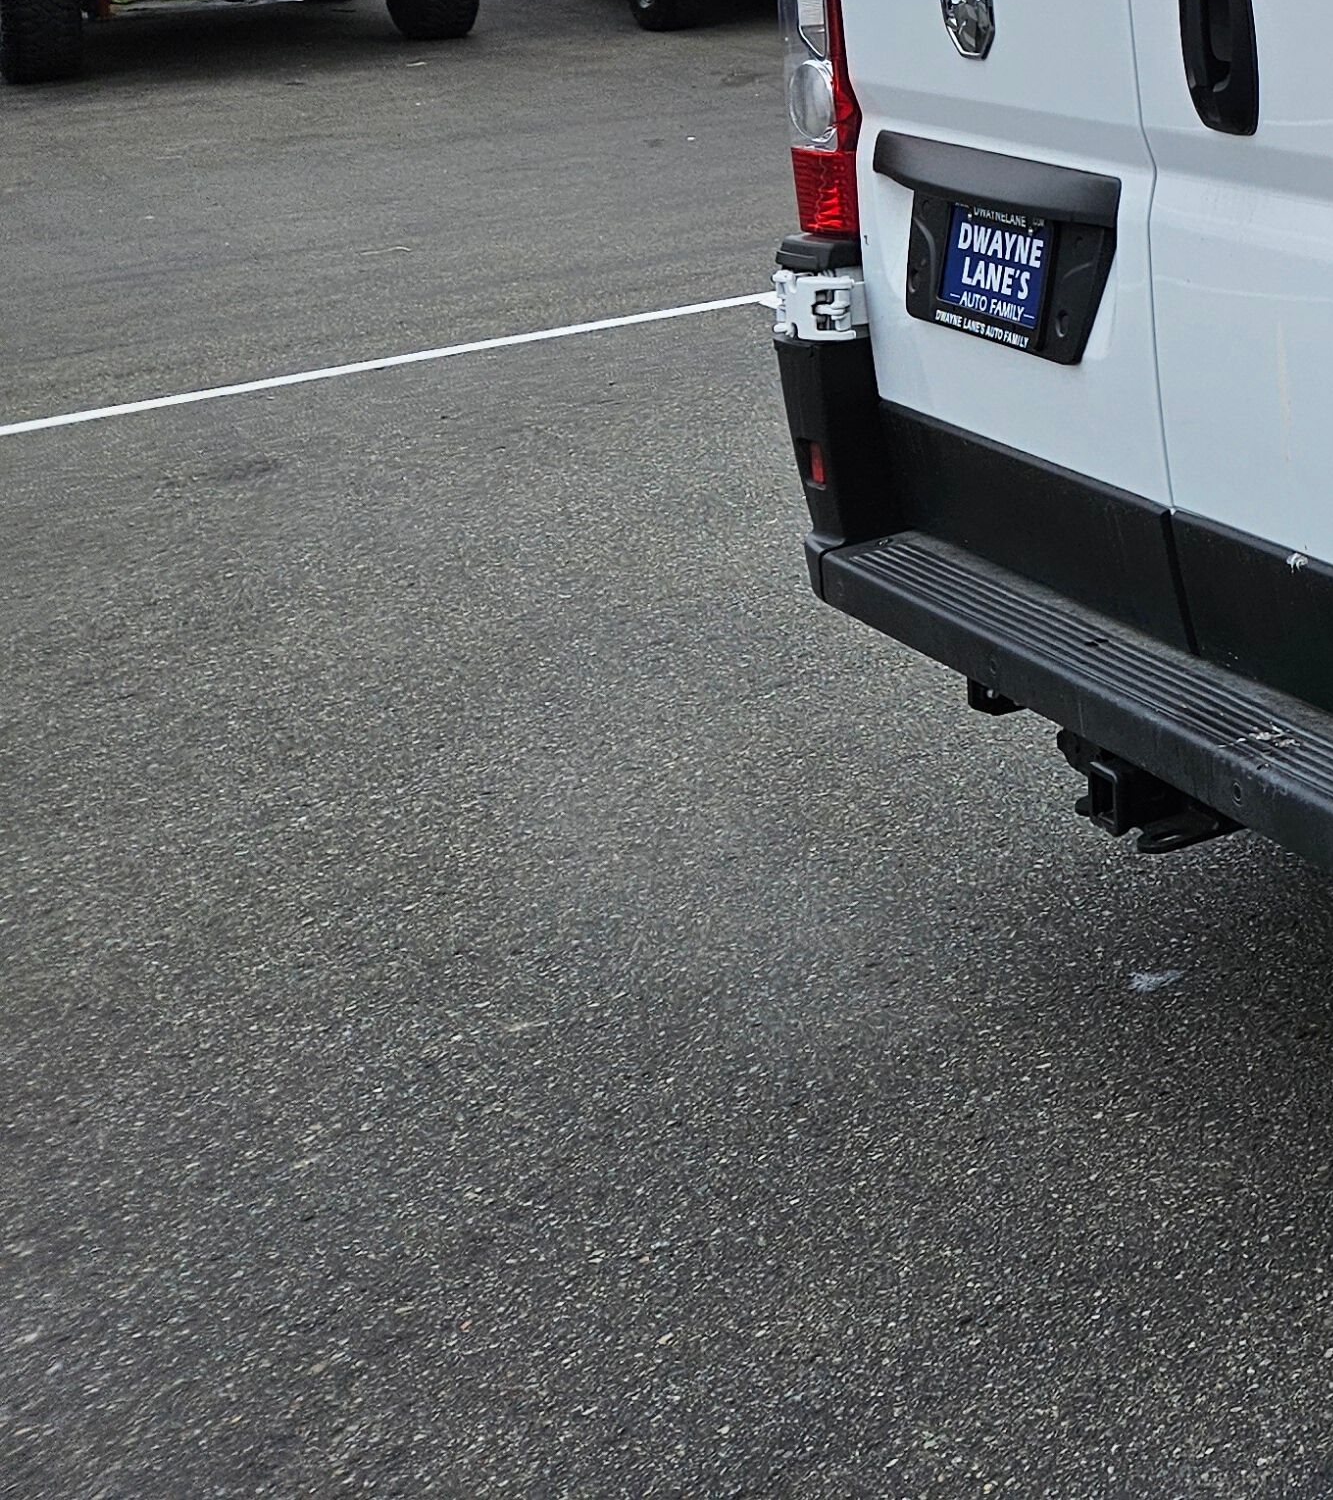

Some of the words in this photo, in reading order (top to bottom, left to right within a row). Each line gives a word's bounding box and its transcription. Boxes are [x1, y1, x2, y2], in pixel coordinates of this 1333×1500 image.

[957, 222, 1044, 268] DWAYNE
[961, 257, 1031, 300] LANE'S
[959, 291, 987, 312] AUTO
[989, 299, 1025, 322] FAMILY
[935, 309, 962, 328] DWAYNE
[963, 319, 986, 336] LANE'S
[985, 327, 1003, 340] AUTO
[1003, 331, 1029, 348] FAMILY
